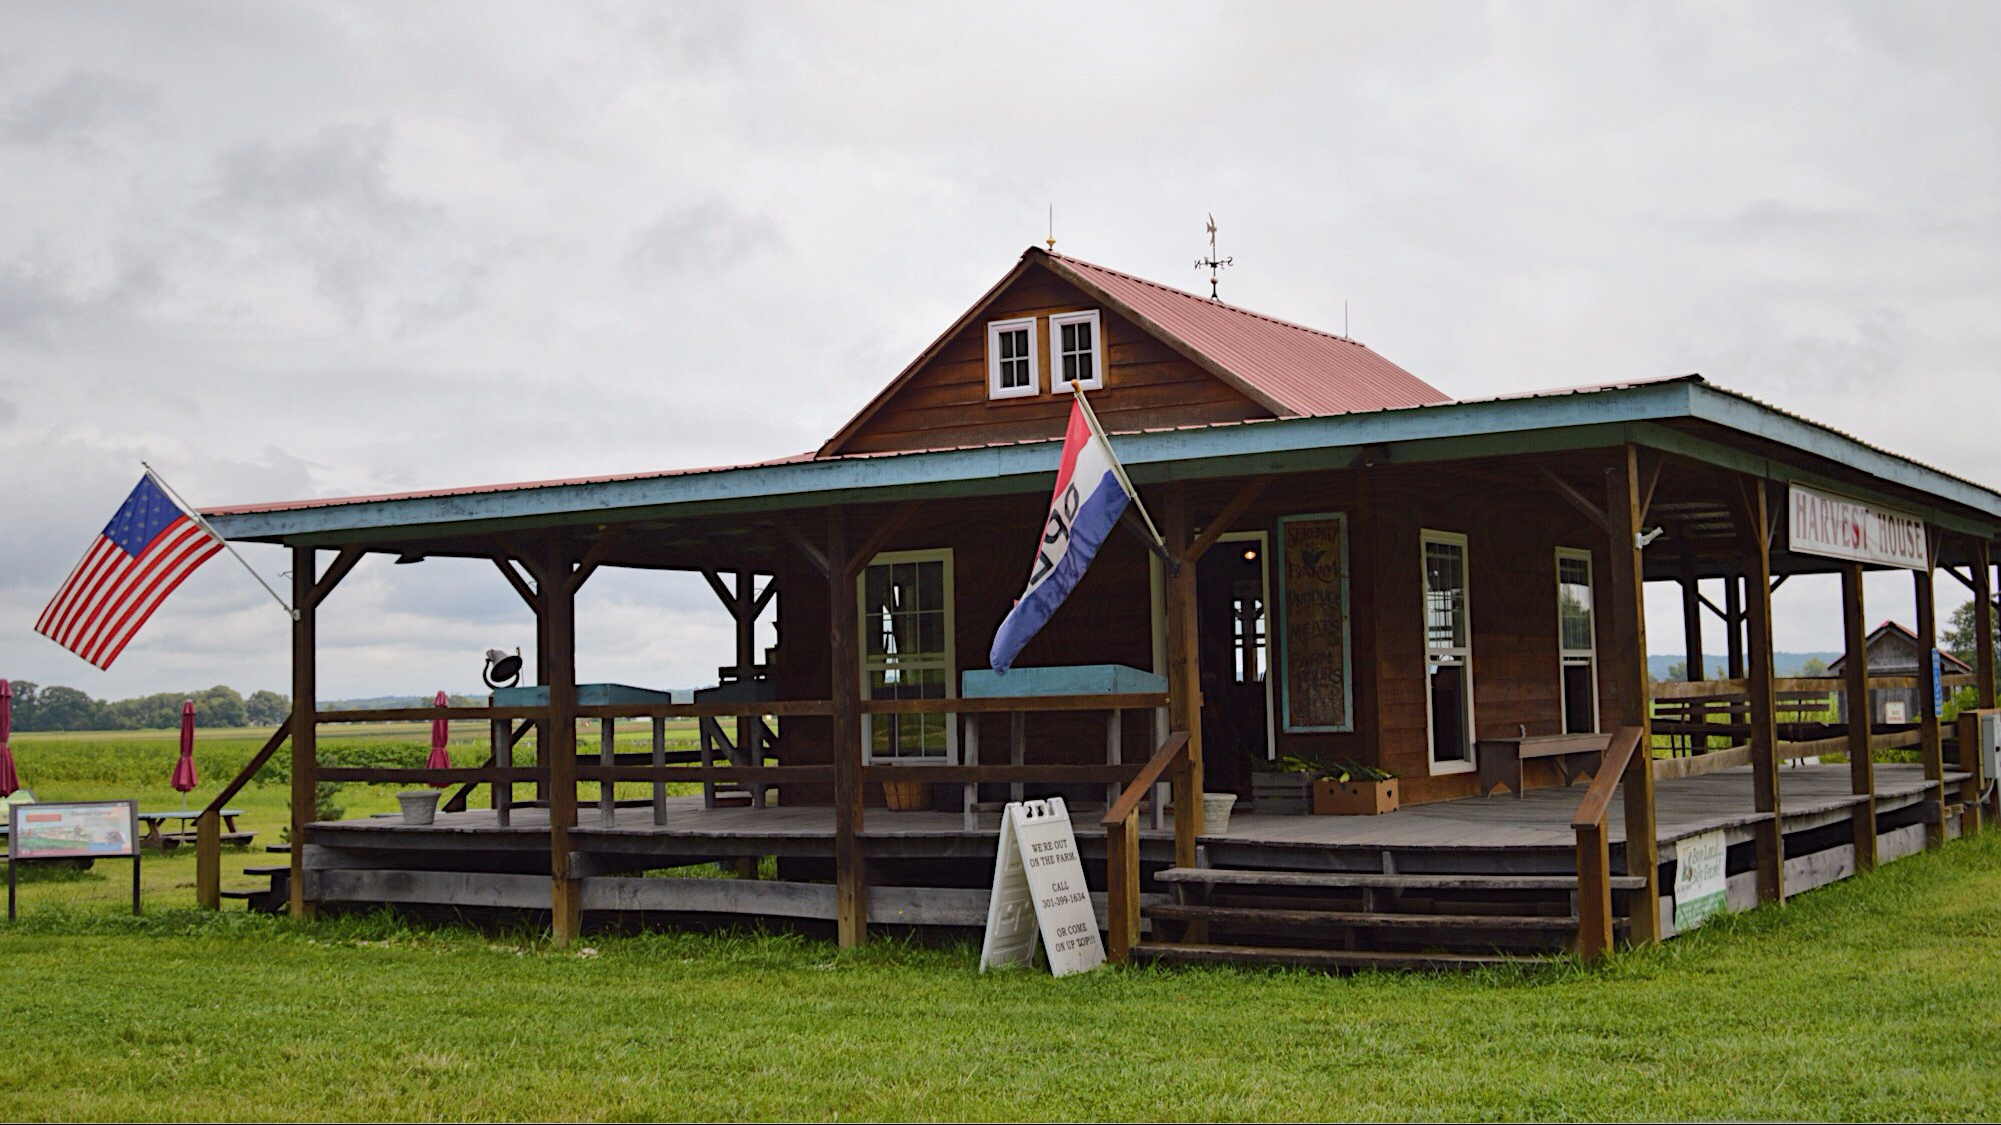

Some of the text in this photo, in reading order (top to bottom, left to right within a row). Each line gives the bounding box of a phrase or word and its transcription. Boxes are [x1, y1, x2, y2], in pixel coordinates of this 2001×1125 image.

[1795, 493, 1923, 560] HARVEST HOUSE
[1032, 839, 1067, 853] WE'RE OUT
[1030, 858, 1040, 868] ON
[1041, 855, 1055, 866] THE
[1052, 881, 1069, 892] CALL
[1042, 892, 1085, 909] 301-399-1634
[1057, 923, 1087, 937] OR COME
[1056, 942, 1065, 952] ON
[1066, 940, 1075, 950] UP
